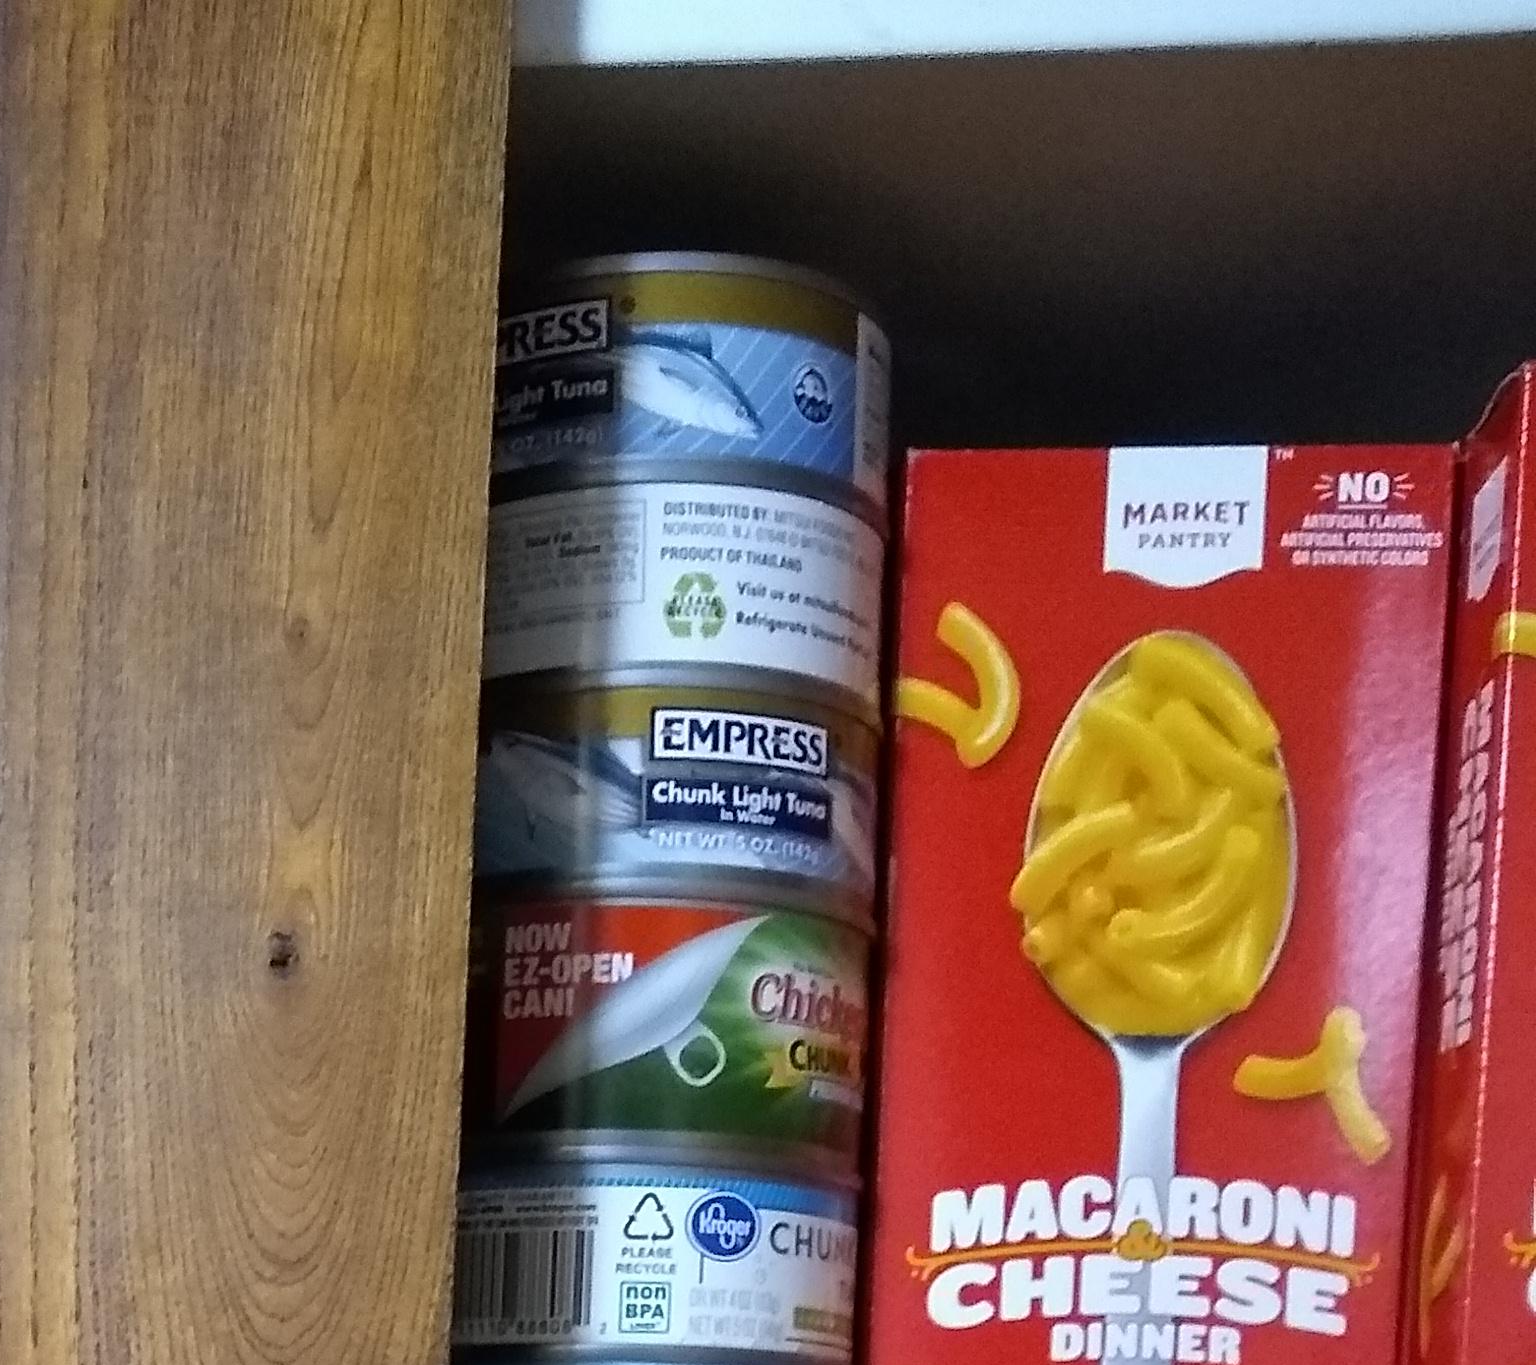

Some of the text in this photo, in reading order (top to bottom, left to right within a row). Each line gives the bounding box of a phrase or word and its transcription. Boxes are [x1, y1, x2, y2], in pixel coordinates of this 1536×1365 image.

[498, 308, 602, 357] RESS
[552, 378, 609, 400] Tuna
[1338, 471, 1391, 503] NO
[663, 501, 750, 520] DISTRIBUTED
[1124, 500, 1251, 529] MARKET
[1302, 514, 1364, 529] ARTIFICIAL
[1138, 533, 1231, 549] PANTRY
[1280, 532, 1444, 549] ARTIFICIAL PRESERVATIVES
[660, 547, 803, 573] PRODUCT OF THAILAND
[1312, 550, 1380, 566] SYNTHETIC
[1381, 550, 1429, 566] COLORS
[662, 716, 824, 767] EMPRESS
[652, 780, 827, 820] Chunk Light Tuna
[736, 809, 776, 826] Water
[658, 831, 693, 848] NET
[699, 831, 726, 849] WT
[504, 921, 572, 955] NOW
[503, 951, 635, 988] EZ-OPEN
[502, 987, 576, 1021] CAN!
[697, 1202, 752, 1250] Kroger
[928, 1172, 1358, 1259] MACARONI
[620, 1247, 674, 1259] PLEASE
[615, 1262, 679, 1275] RECYCLE
[625, 1285, 667, 1300] non
[925, 1256, 1352, 1339] CHEESE
[625, 1303, 665, 1319] BPA
